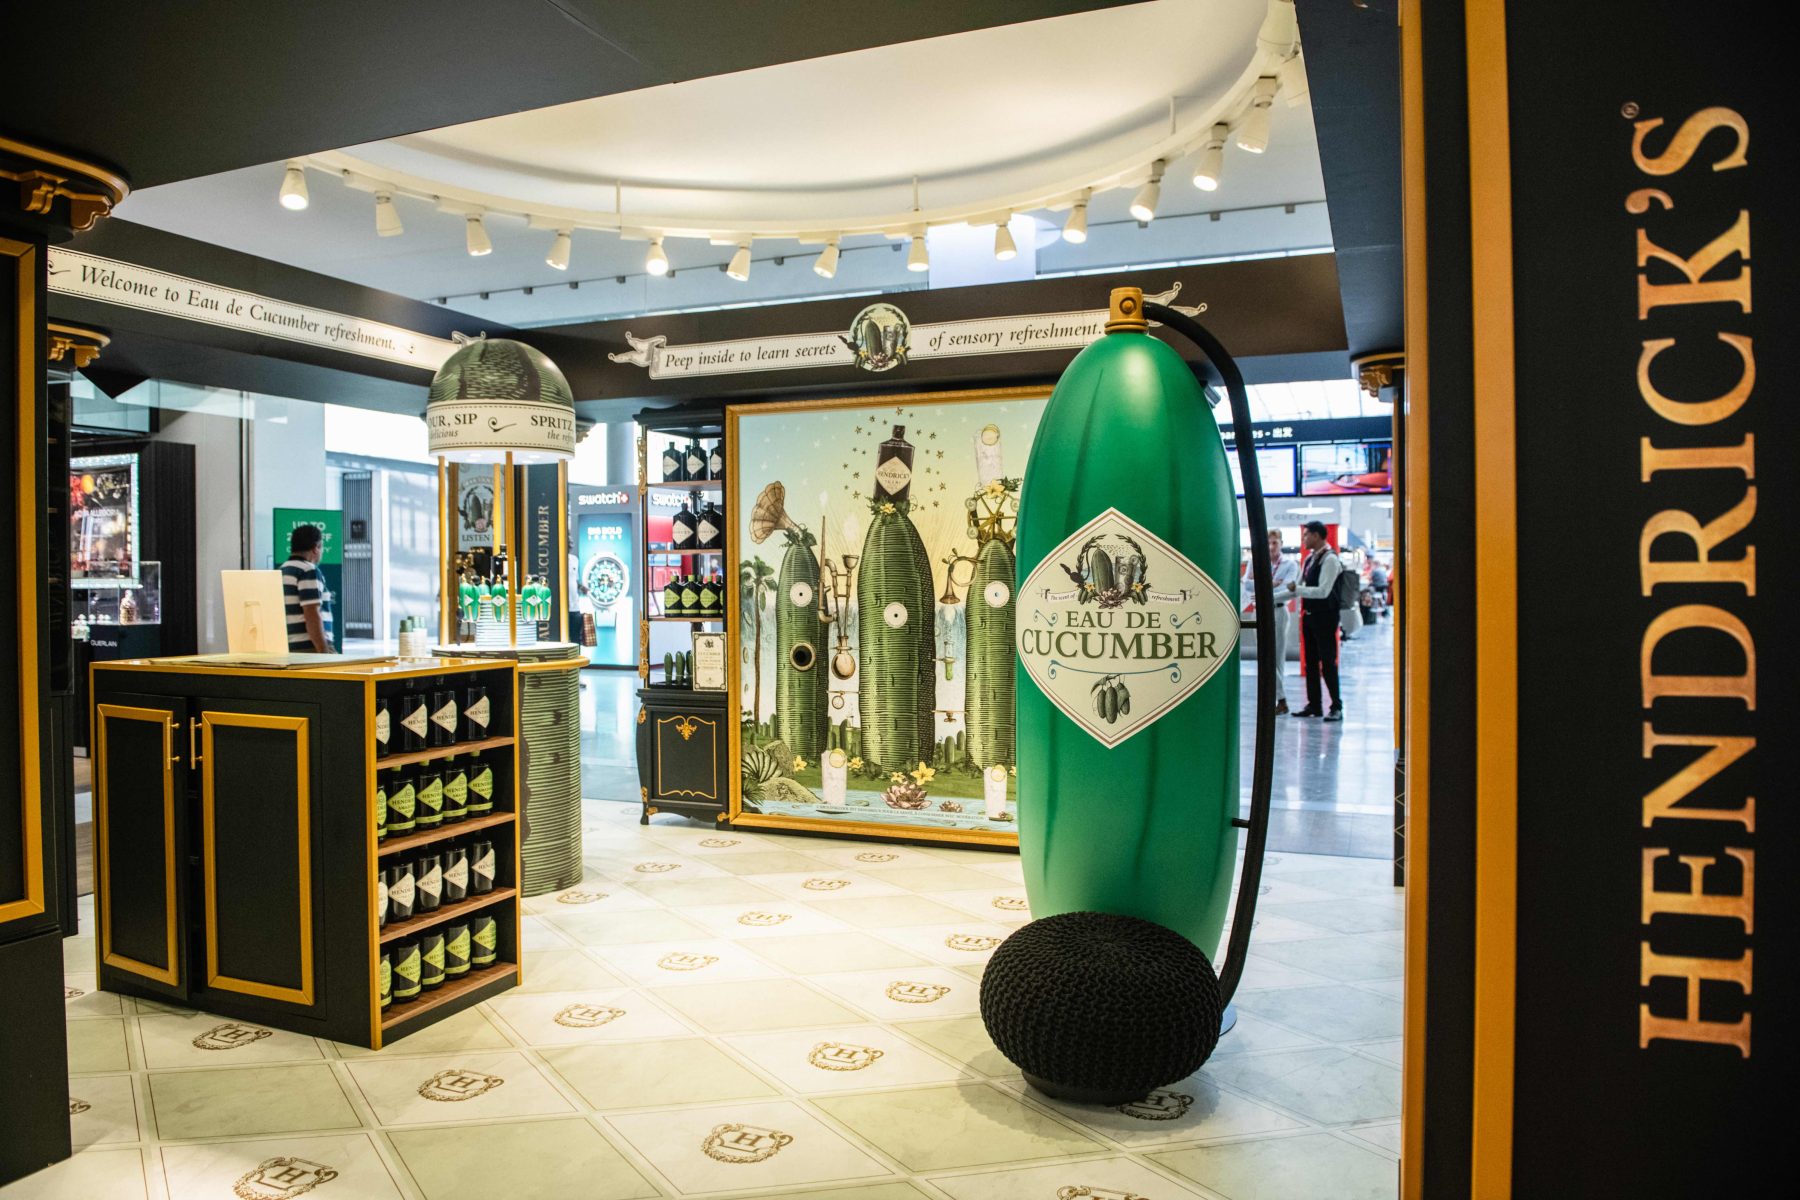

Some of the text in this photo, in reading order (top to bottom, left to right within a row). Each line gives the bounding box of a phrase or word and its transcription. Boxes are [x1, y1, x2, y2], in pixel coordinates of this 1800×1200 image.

[81, 264, 397, 351] Welcome to Eau de Cucumber refreshment.
[665, 322, 1103, 371] Peep inside to learn secrets of sensory refreshment.
[454, 413, 478, 425] SIP
[547, 429, 560, 440] the
[578, 491, 621, 506] swatch
[462, 534, 490, 542] LISTEN
[537, 504, 550, 581] UCUMBER
[1624, 105, 1757, 1059] HENDRICK'S
[1065, 610, 1162, 629] EAU DE
[1022, 628, 1220, 660] CUCUMBER
